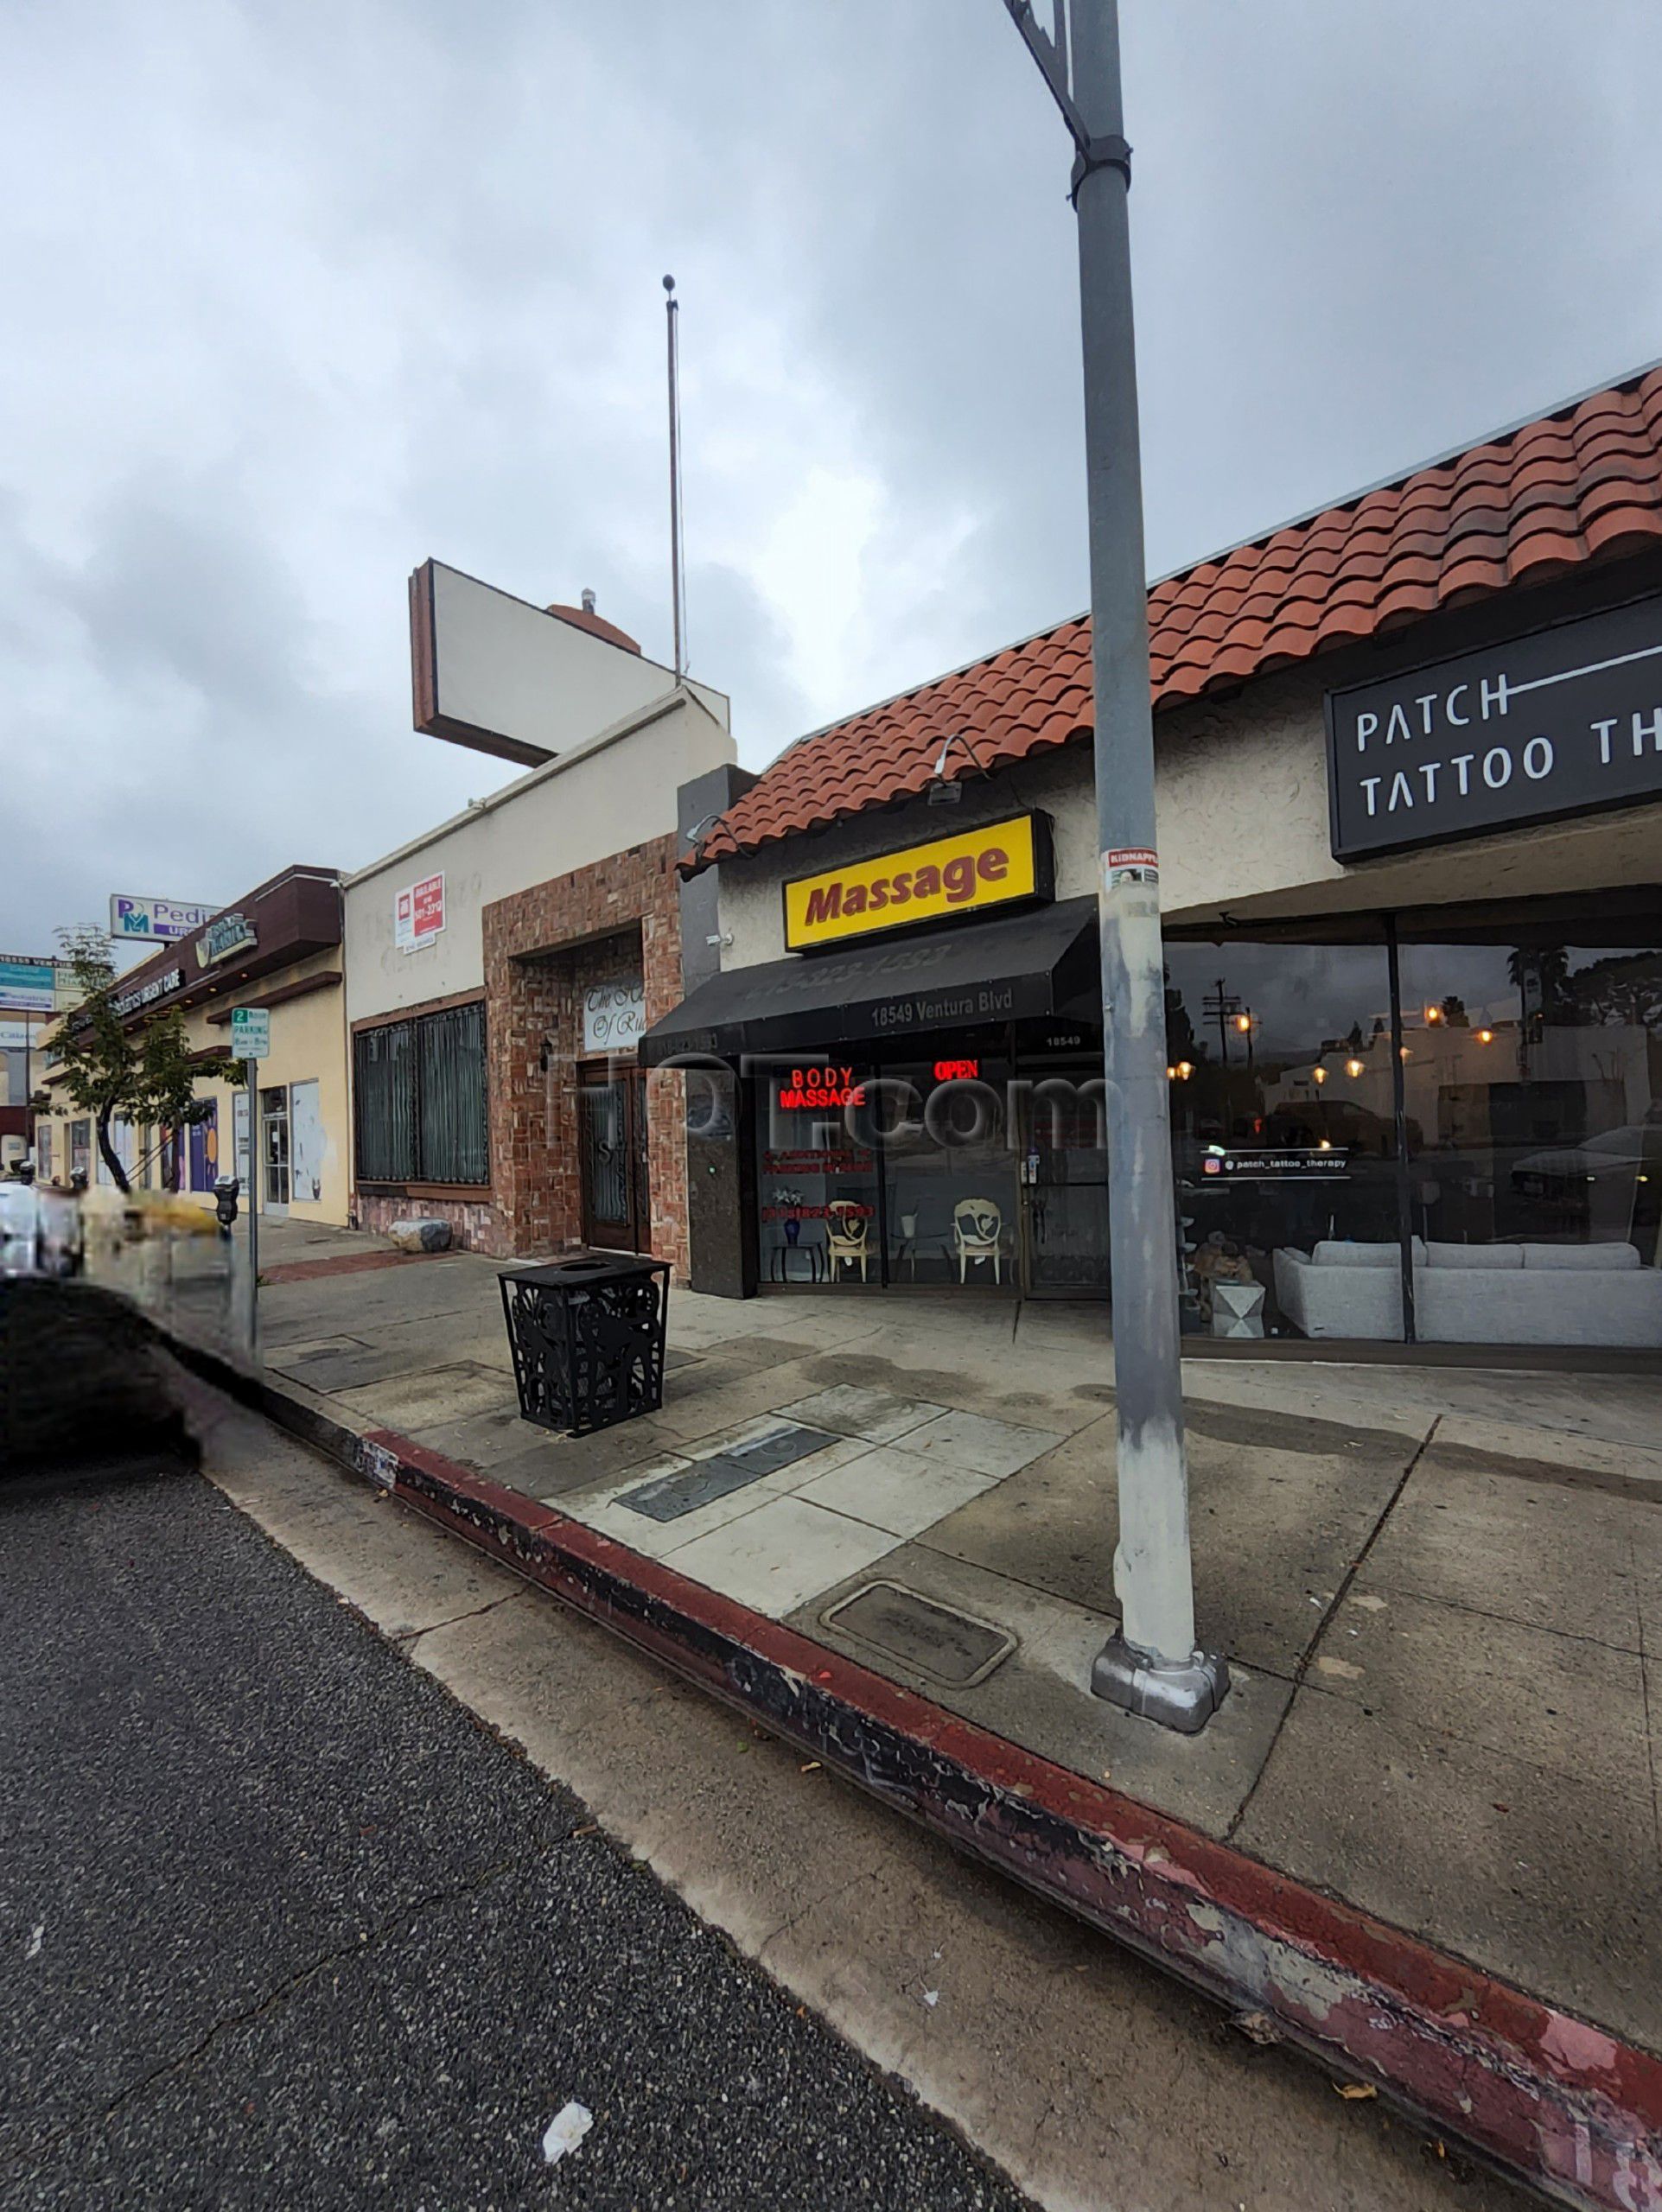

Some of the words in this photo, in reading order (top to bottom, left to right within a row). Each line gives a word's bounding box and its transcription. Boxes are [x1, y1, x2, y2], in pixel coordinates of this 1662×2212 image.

[1356, 673, 1508, 753] PATCH
[1359, 736, 1554, 816] TATTOO
[804, 847, 1010, 927] Massage
[33, 958, 75, 968] VENTUR
[237, 1011, 244, 1021] 2
[872, 1005, 913, 1027] 18549
[916, 999, 973, 1022] Ventura
[978, 988, 1013, 1012] Blvd
[792, 1066, 853, 1088] BODY
[934, 1059, 978, 1080] OPEN
[780, 1086, 865, 1109] MASSAGE
